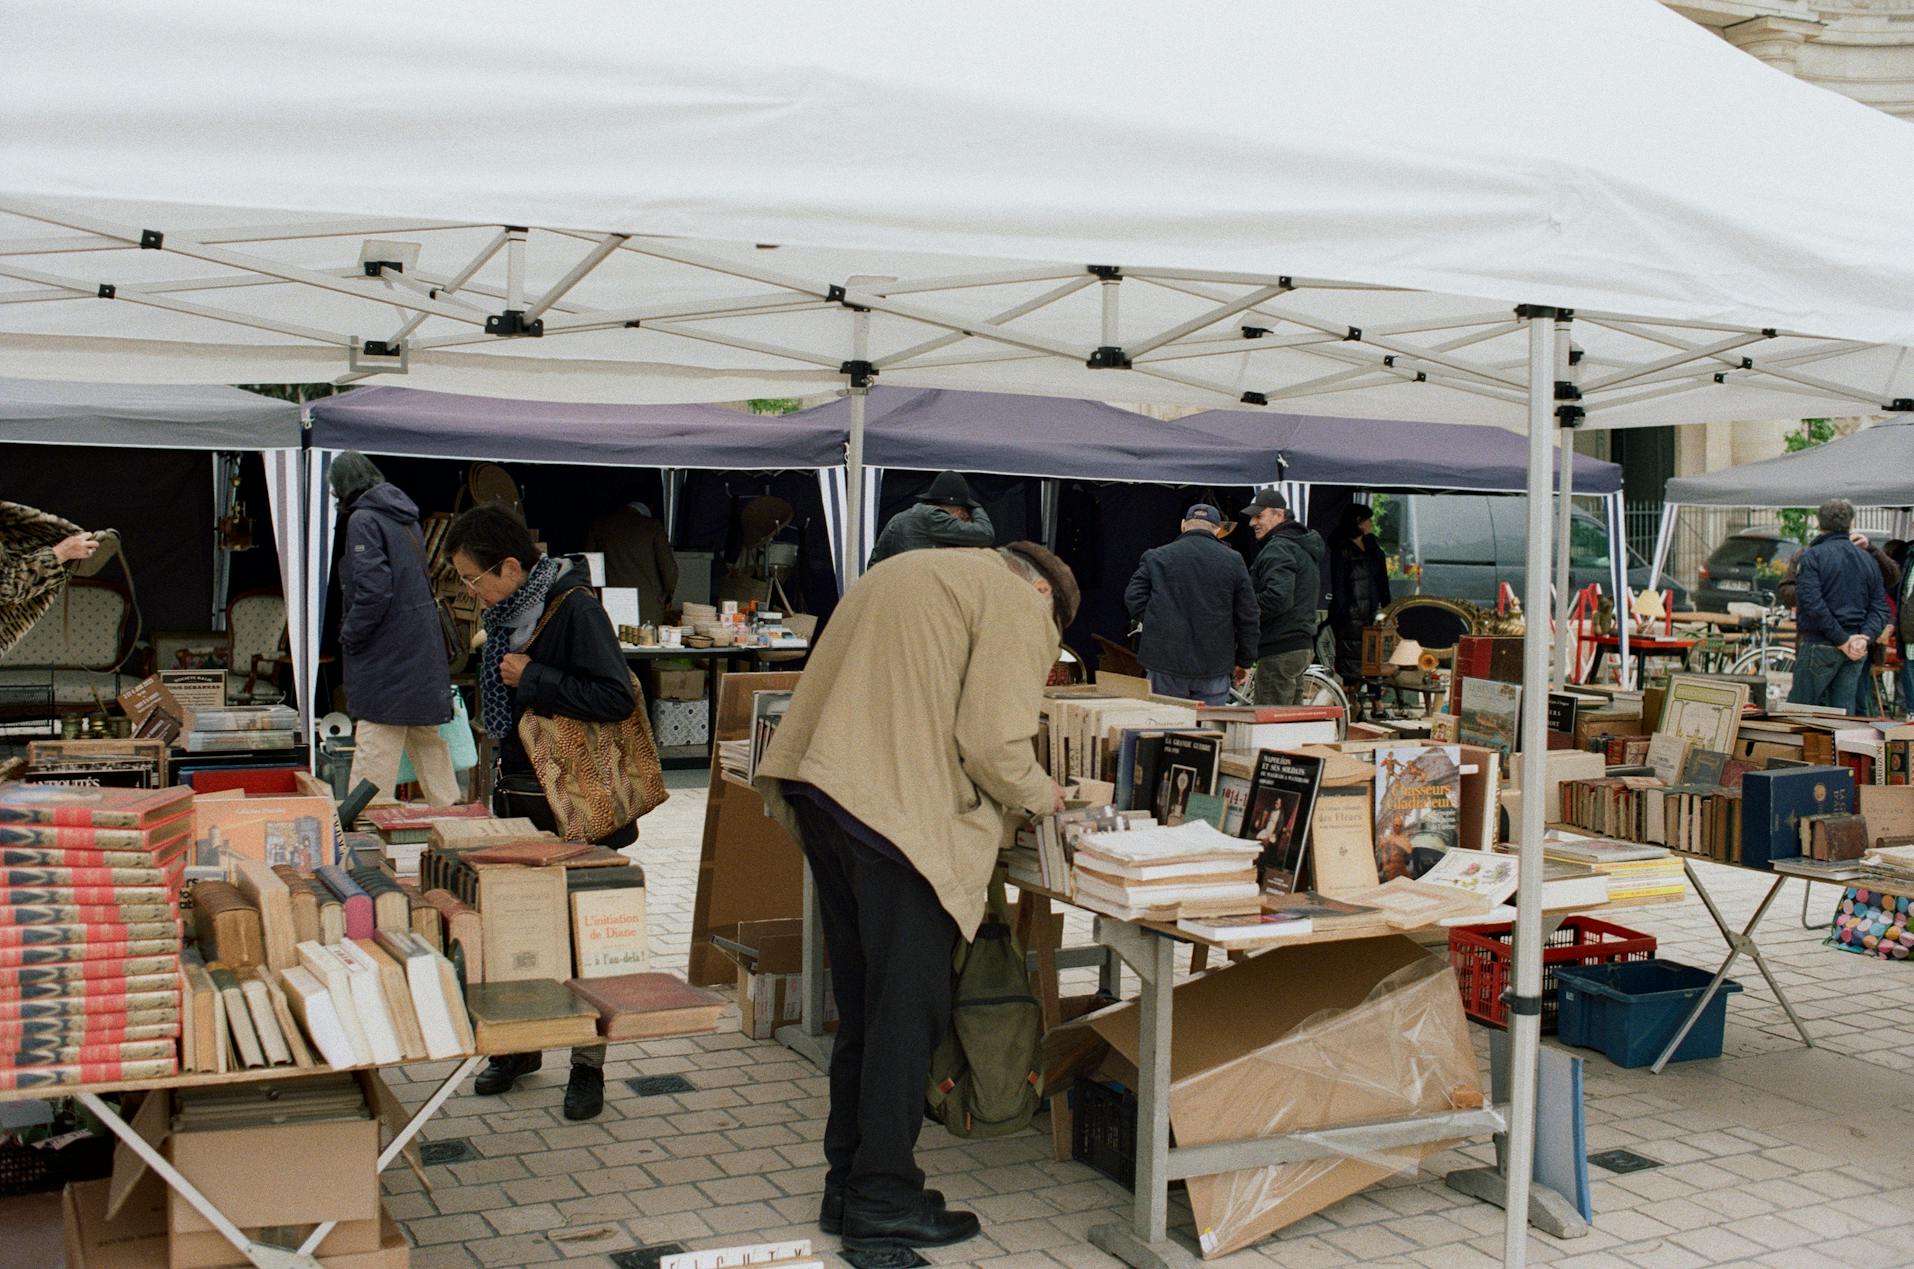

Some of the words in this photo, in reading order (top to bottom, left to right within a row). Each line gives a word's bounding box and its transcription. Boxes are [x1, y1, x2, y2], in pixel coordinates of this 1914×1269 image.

[1391, 781, 1452, 797] Chasseurs
[585, 912, 641, 927] L'initiation
[590, 929, 602, 940] de
[606, 927, 638, 938] Diane
